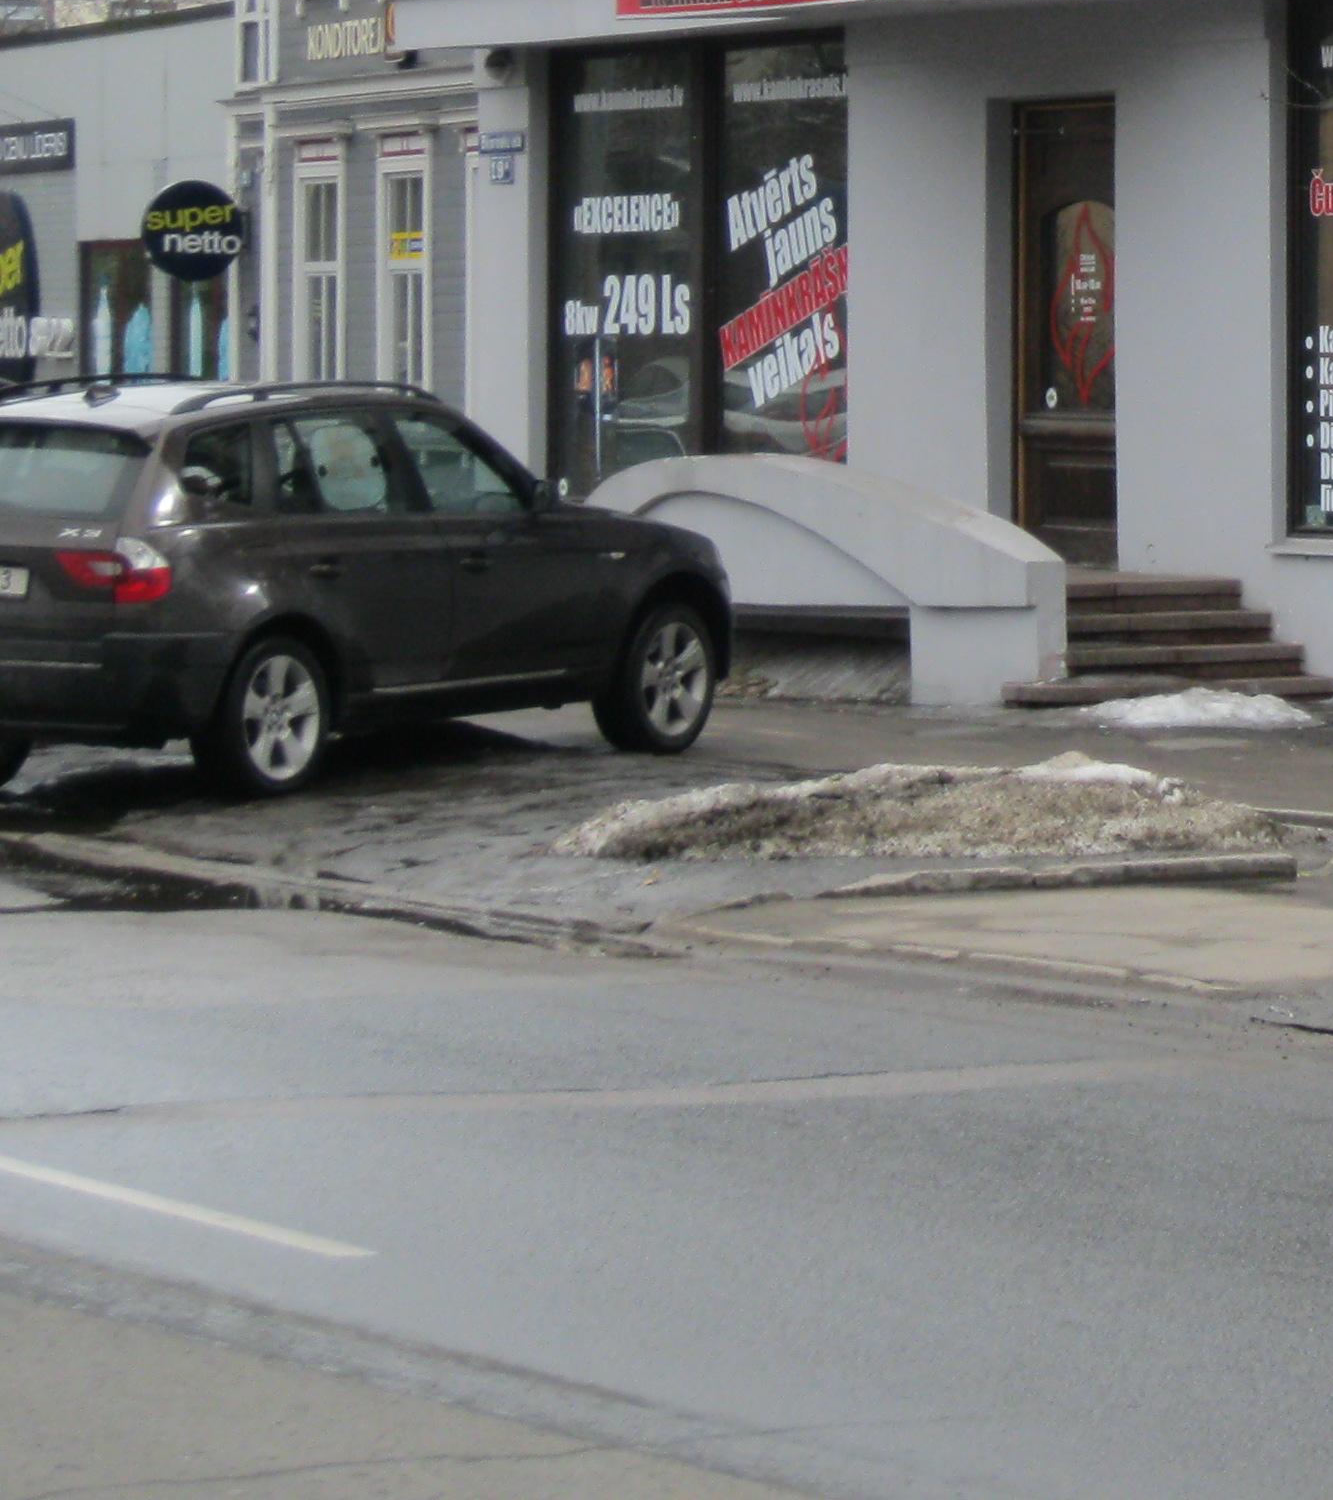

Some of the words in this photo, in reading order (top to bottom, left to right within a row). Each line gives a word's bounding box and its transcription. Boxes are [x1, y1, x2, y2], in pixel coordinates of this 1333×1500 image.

[307, 17, 385, 60] KONDITOREJ
[146, 204, 236, 232] super
[727, 153, 817, 251] Atvērts
[163, 231, 241, 254] netto
[764, 197, 838, 289] jauns
[565, 300, 599, 335] 8kw
[603, 274, 656, 335] 249
[661, 274, 690, 335] Ls
[748, 312, 840, 408] veikals
